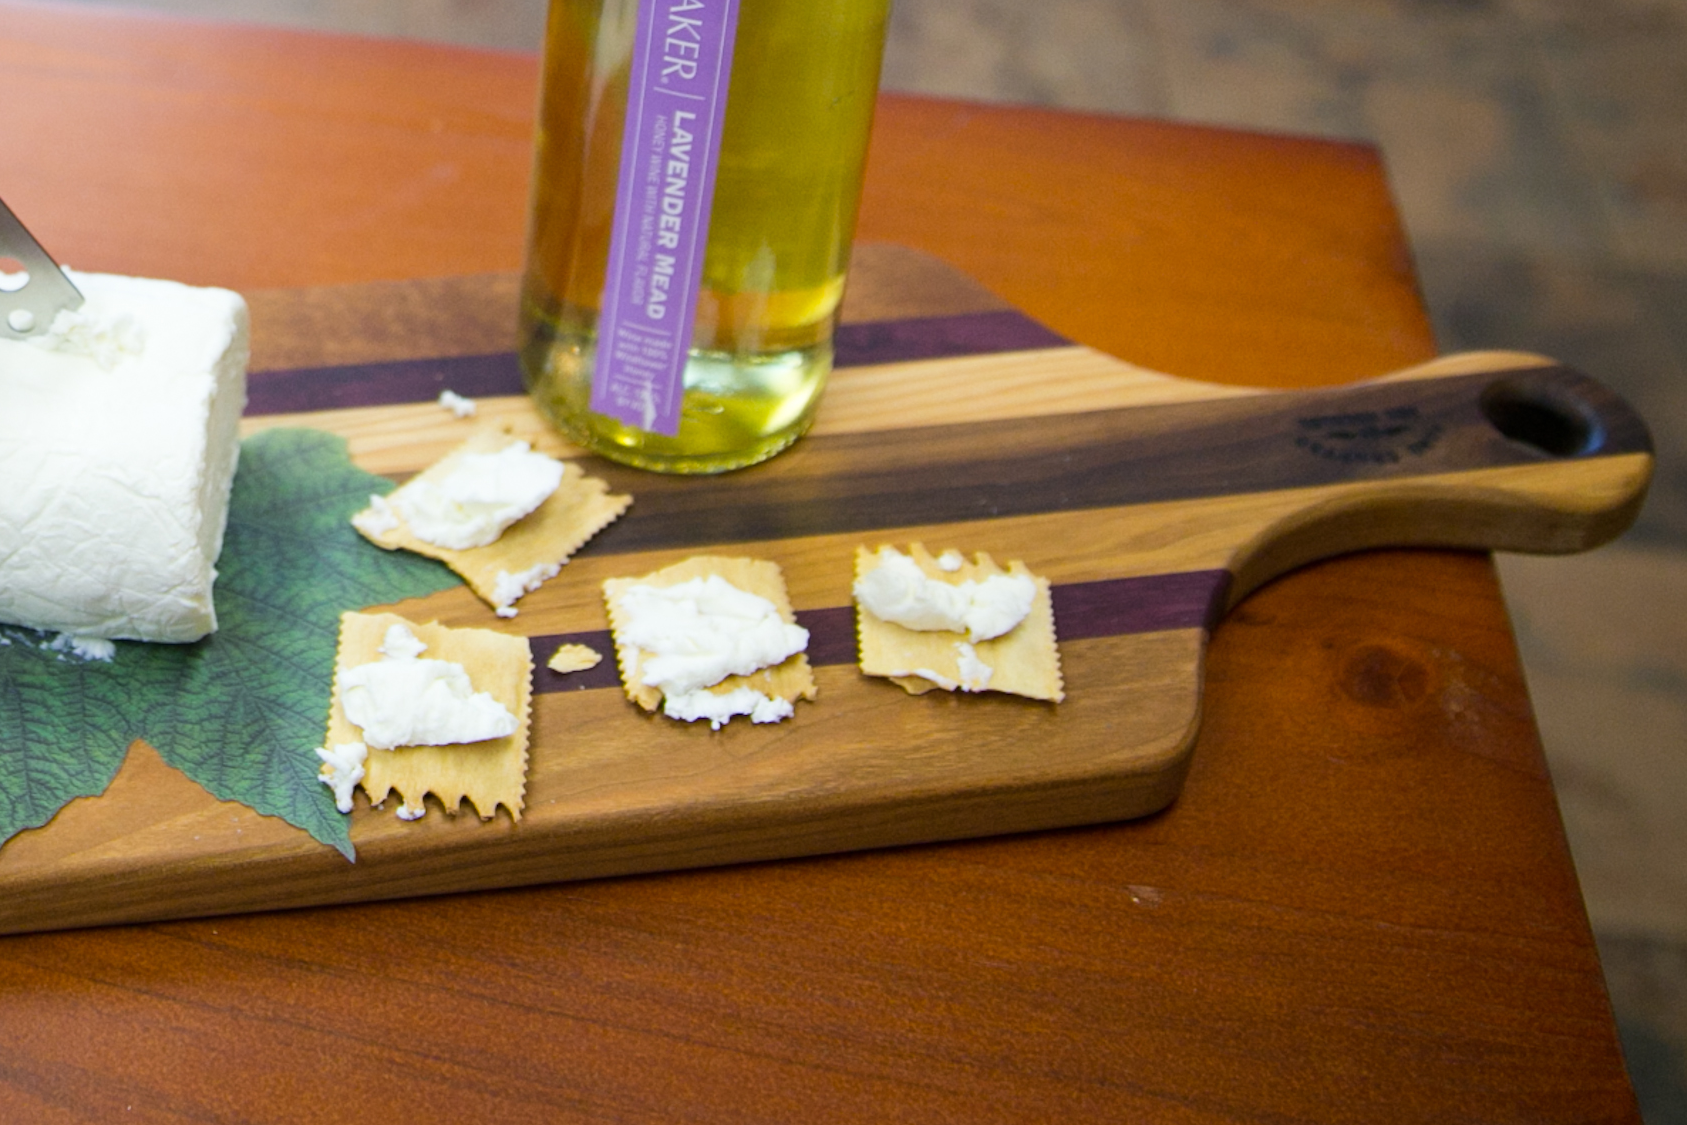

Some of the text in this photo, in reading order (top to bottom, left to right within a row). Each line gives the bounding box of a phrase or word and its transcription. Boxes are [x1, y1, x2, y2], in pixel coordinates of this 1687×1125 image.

[650, 114, 668, 151] HONEY
[646, 154, 663, 184] WINE
[642, 185, 659, 214] WITH
[646, 110, 696, 319] LAVENDER MEAD
[636, 215, 654, 262] NATURAL
